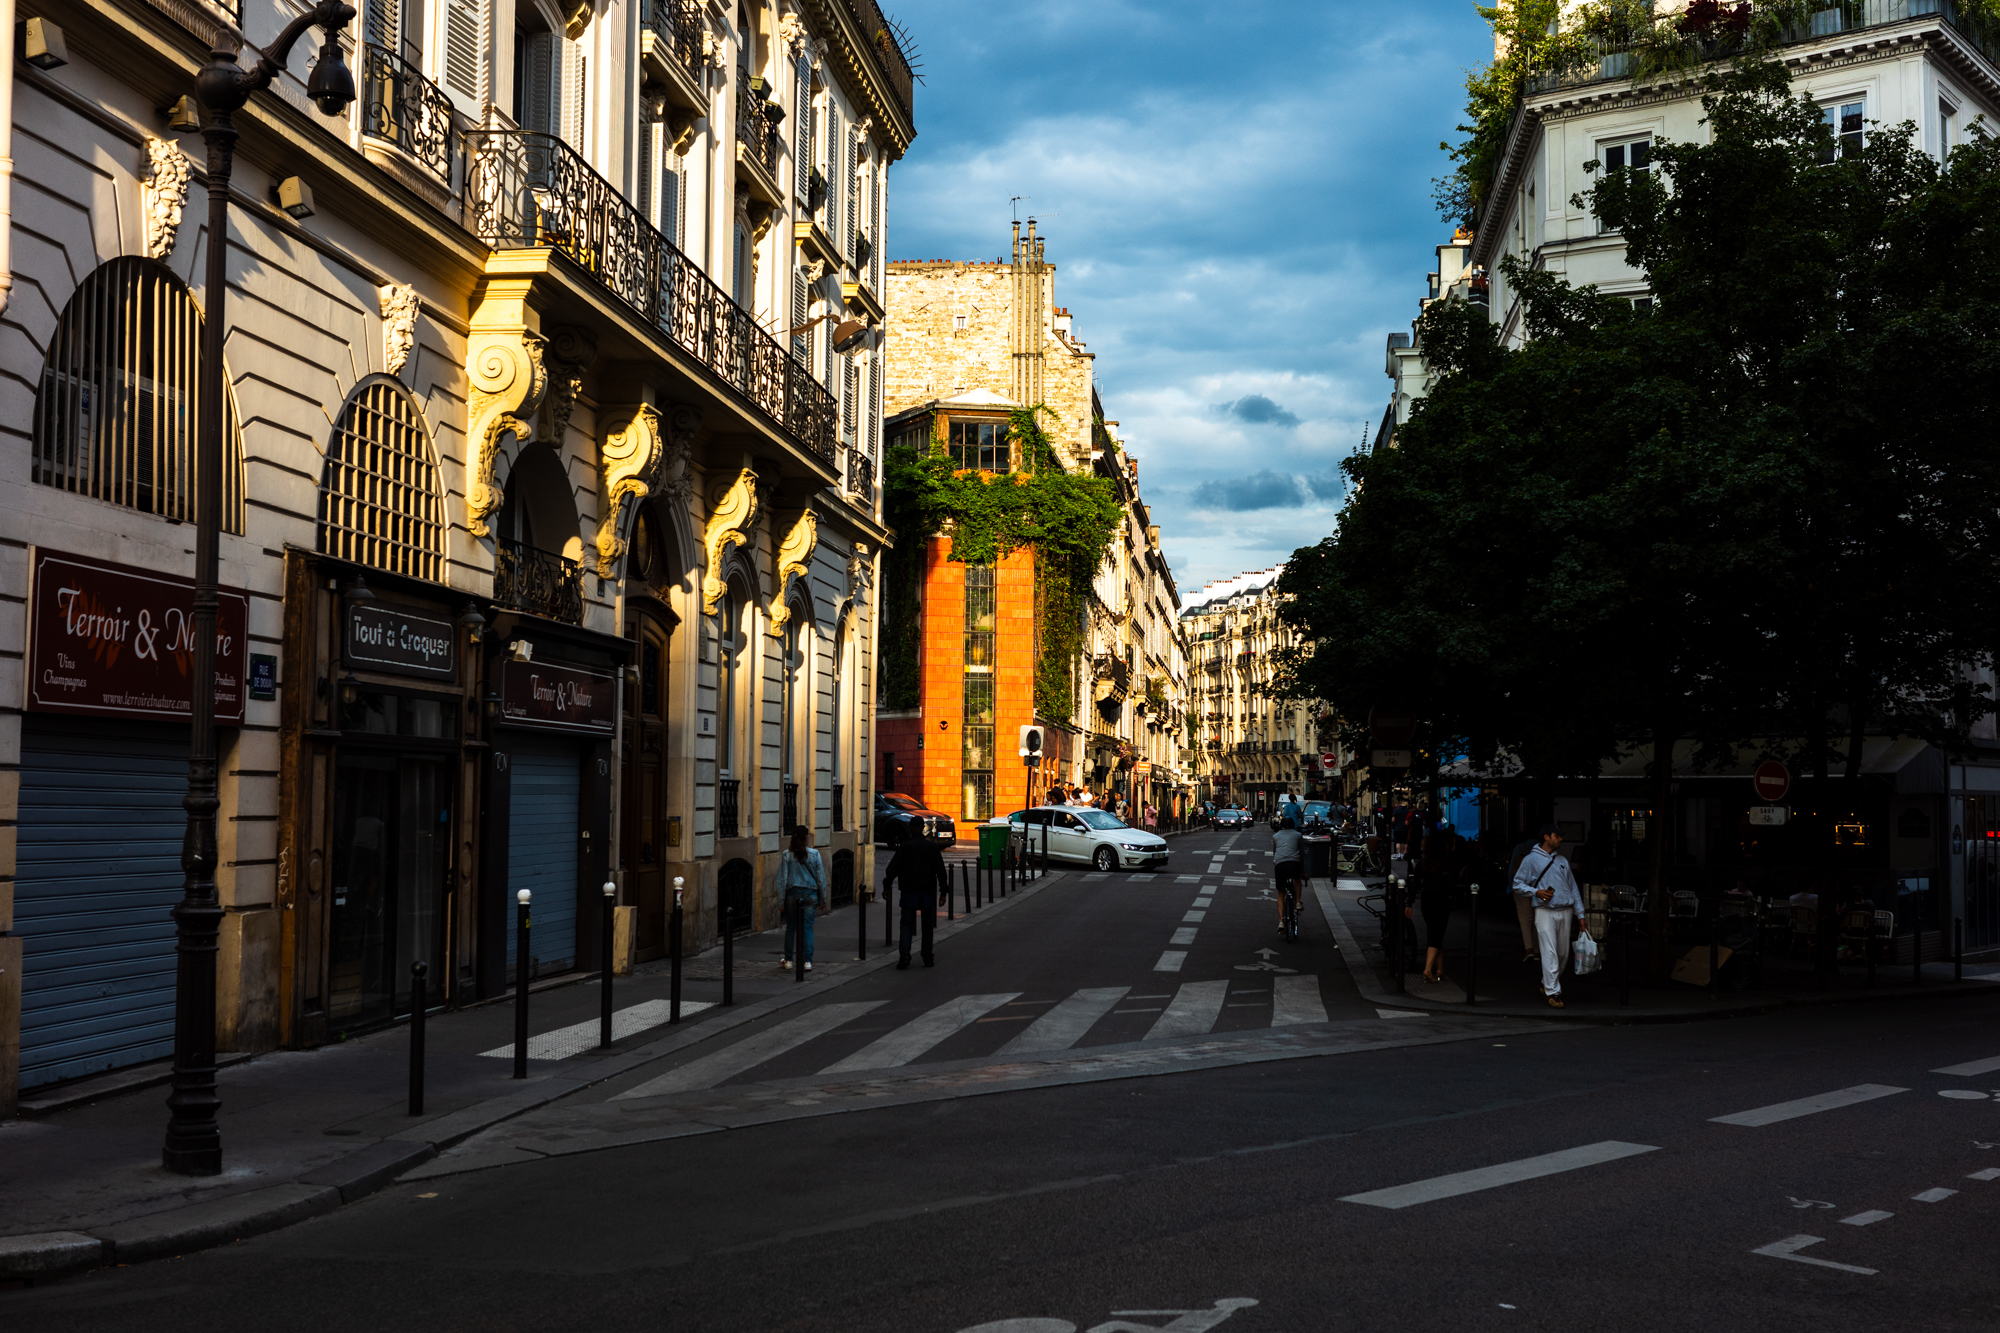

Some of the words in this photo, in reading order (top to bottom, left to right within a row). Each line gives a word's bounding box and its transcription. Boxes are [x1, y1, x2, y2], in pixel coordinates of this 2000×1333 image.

[57, 587, 131, 643] Terroir
[134, 608, 160, 662] &
[353, 615, 383, 645] Tout
[386, 620, 395, 648] à
[400, 624, 450, 662] Croquer
[57, 652, 76, 670] Vins
[259, 665, 269, 676] RUE
[43, 668, 88, 693] Champagnes
[254, 677, 260, 688] DE
[260, 678, 273, 689] DOUAI
[530, 674, 556, 702] Terroir
[556, 682, 567, 711] &
[567, 680, 593, 708] Nature
